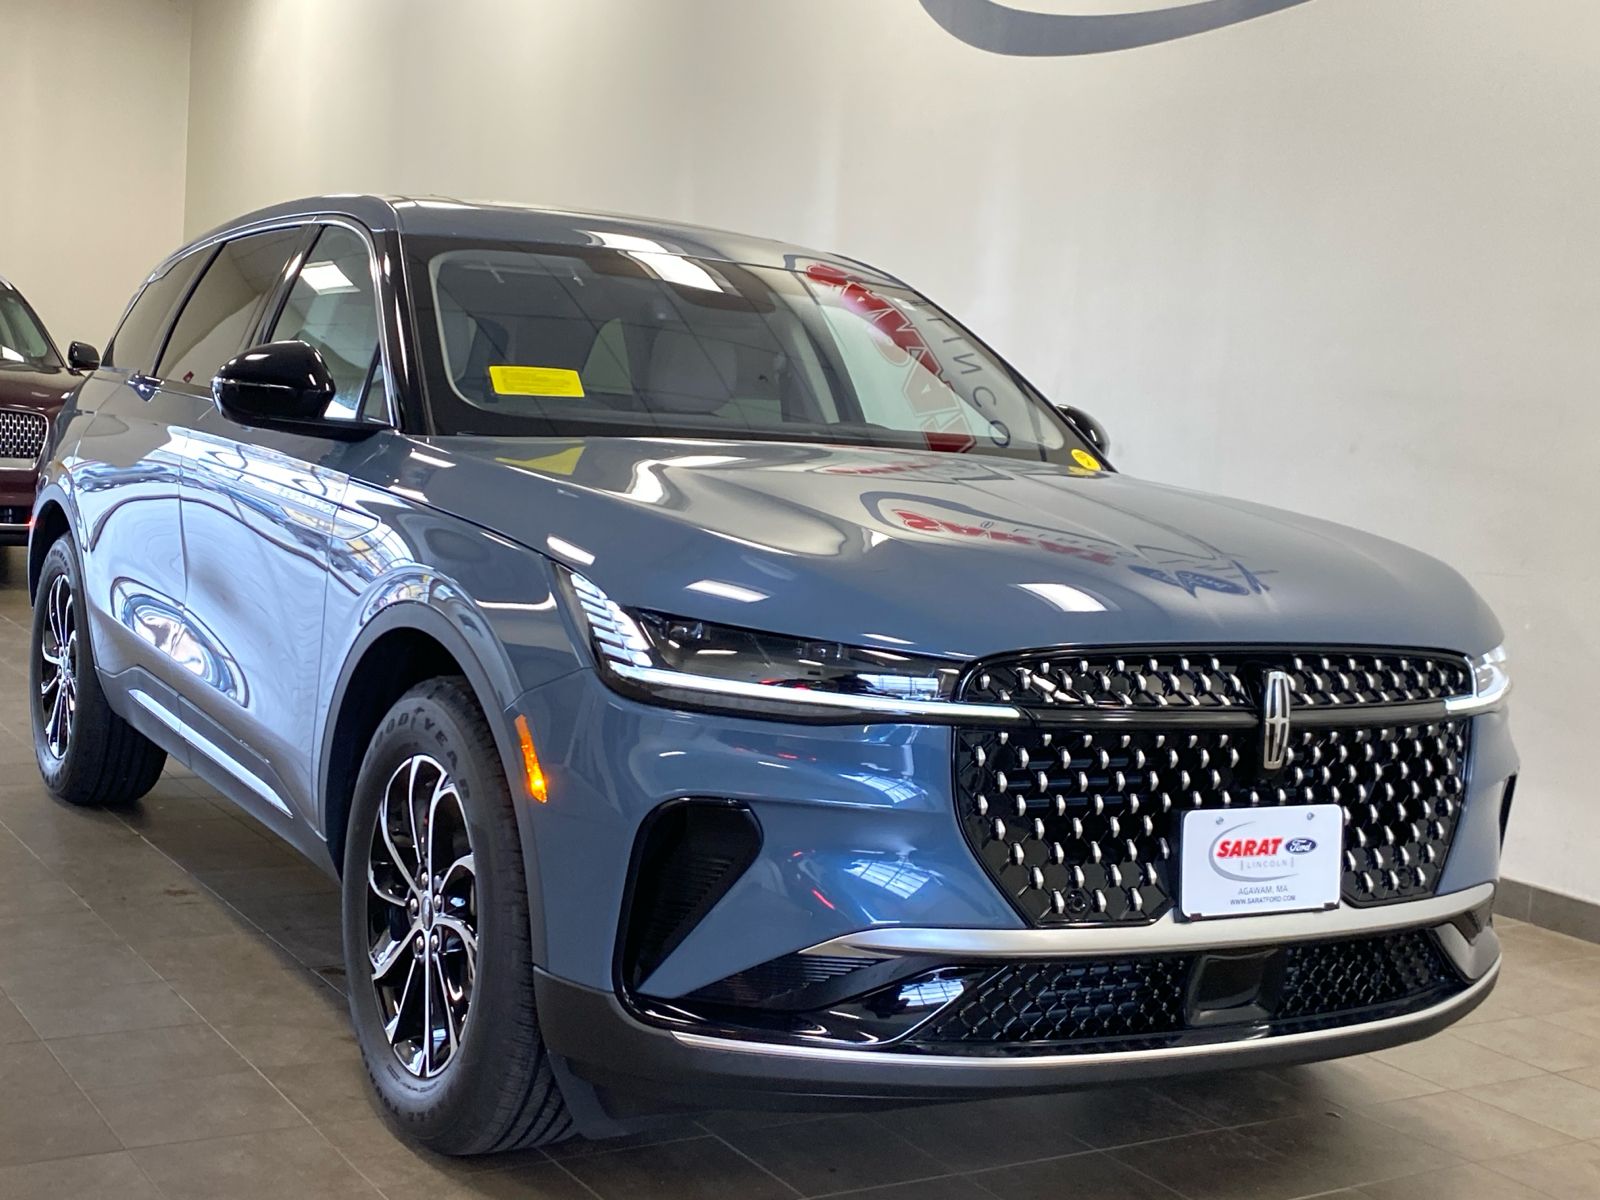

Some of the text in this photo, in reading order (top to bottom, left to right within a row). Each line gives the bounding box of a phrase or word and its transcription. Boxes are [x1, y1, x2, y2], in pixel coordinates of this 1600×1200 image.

[1217, 836, 1314, 858] SARAT Ford
[1247, 859, 1288, 869] LINCOLN
[1238, 884, 1289, 896] AGAWAM, MA
[1230, 895, 1296, 905] WWW.SARATFORD.COM
